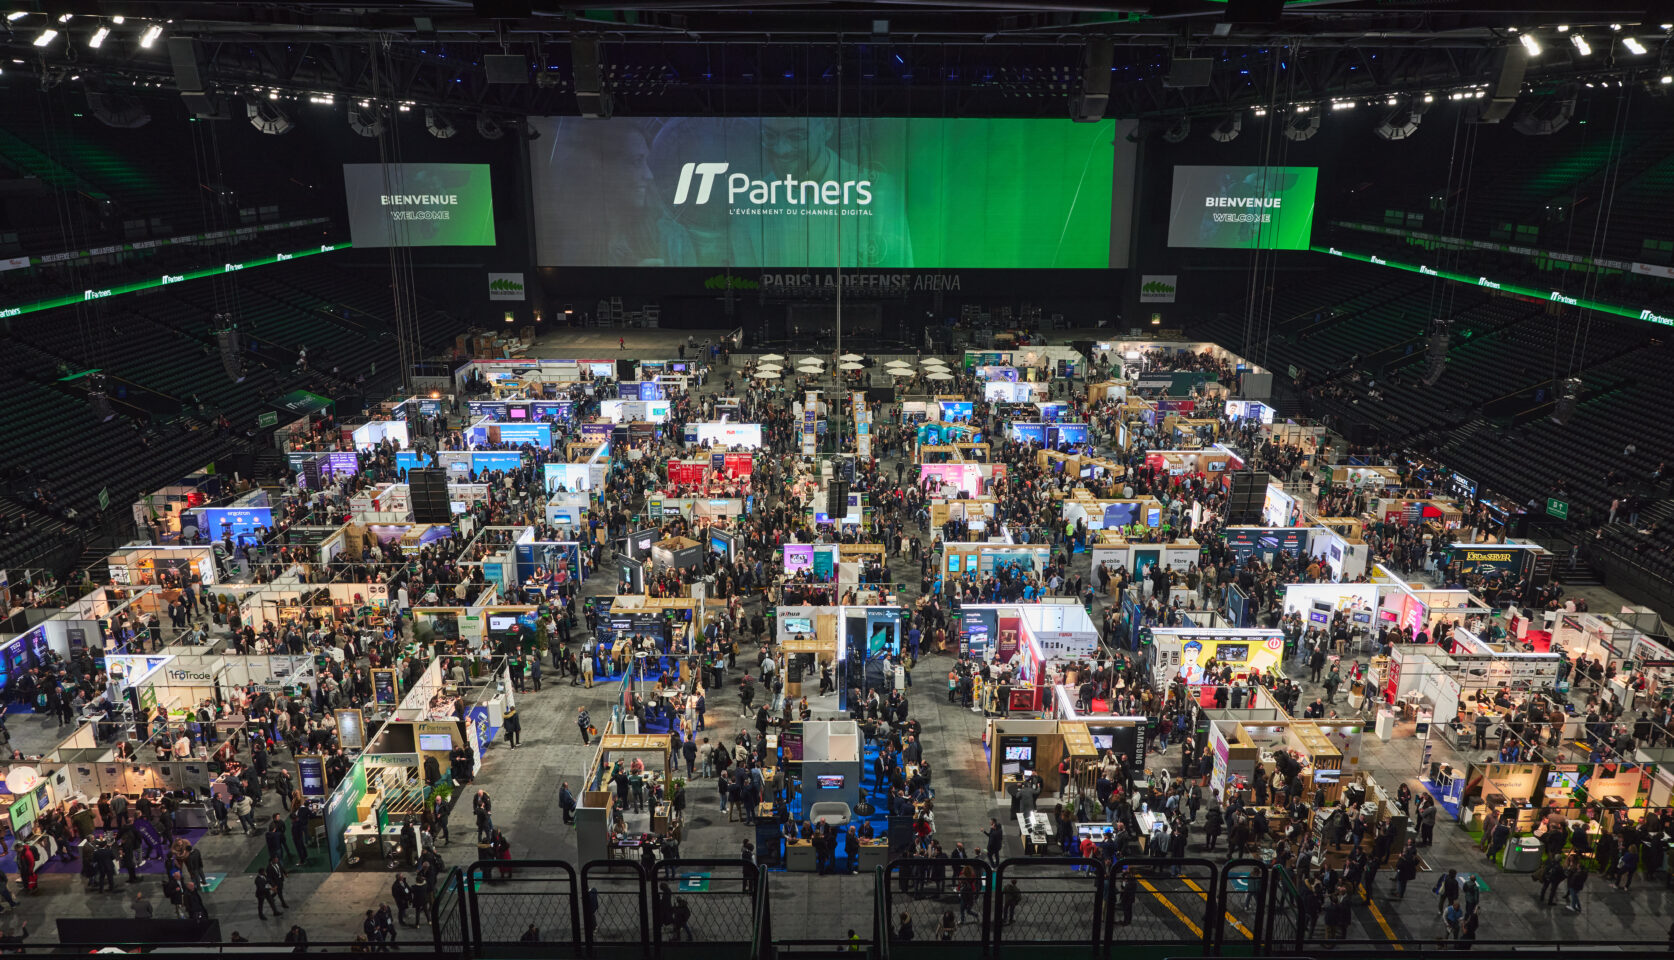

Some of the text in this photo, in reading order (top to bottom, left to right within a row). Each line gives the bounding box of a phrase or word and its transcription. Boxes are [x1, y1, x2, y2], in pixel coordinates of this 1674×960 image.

[673, 162, 872, 205] IT Partners
[380, 194, 458, 206] BIENVENUE
[1205, 196, 1282, 208] BIENVENUE
[390, 211, 450, 220] WELCOME
[1213, 213, 1271, 223] WELCOME
[914, 274, 961, 290] ARENA
[85, 290, 112, 300] IT Partners
[1551, 292, 1577, 305] IT Partners
[1640, 310, 1674, 326] IT Partners
[1135, 726, 1146, 765] SAMSUNG
[370, 755, 381, 763] IT
